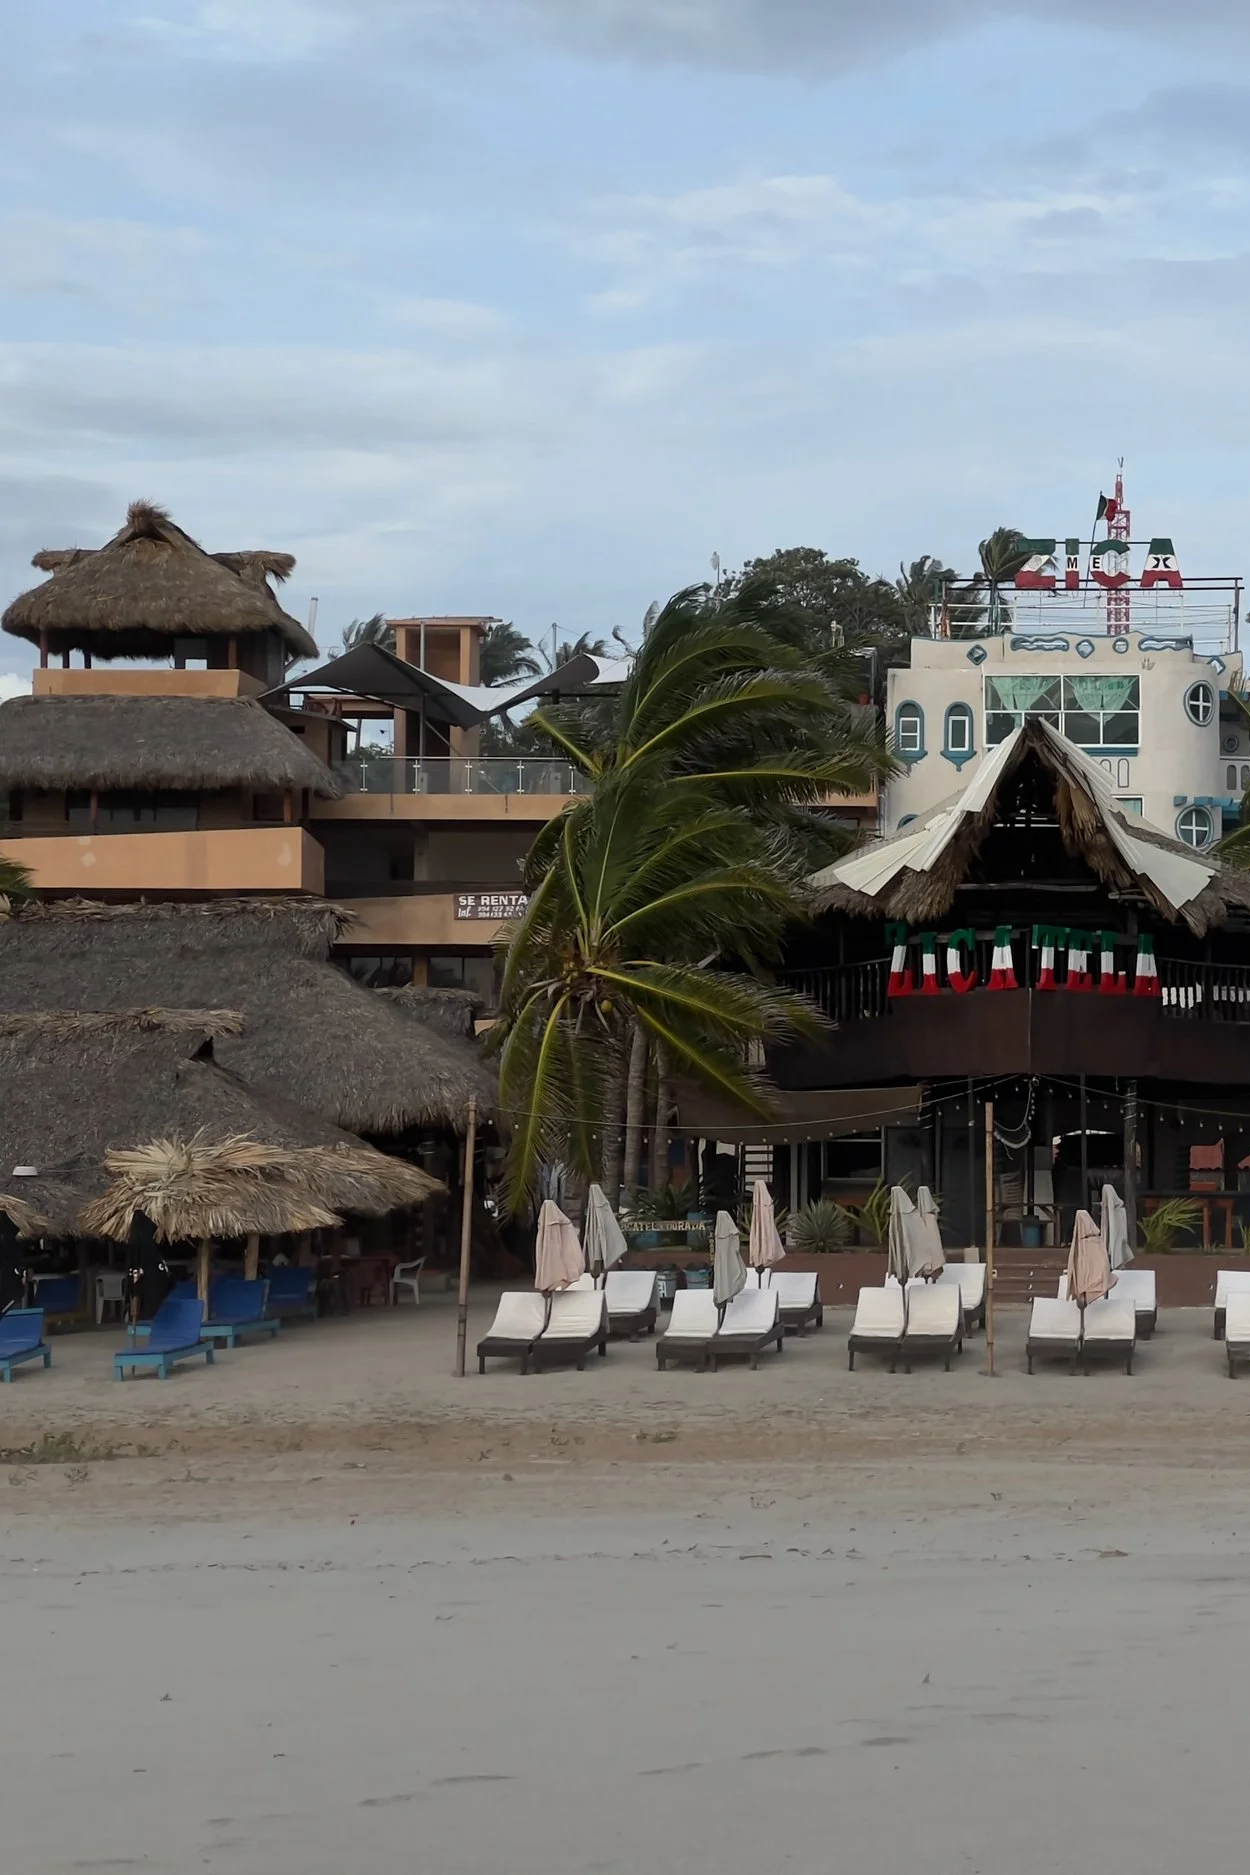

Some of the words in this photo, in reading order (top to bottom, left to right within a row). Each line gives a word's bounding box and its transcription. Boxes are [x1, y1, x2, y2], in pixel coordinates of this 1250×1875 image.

[1014, 537, 1184, 590] ZICA
[458, 895, 476, 906] SE
[480, 895, 528, 906] RENTA
[884, 920, 1161, 997] ZICATELA
